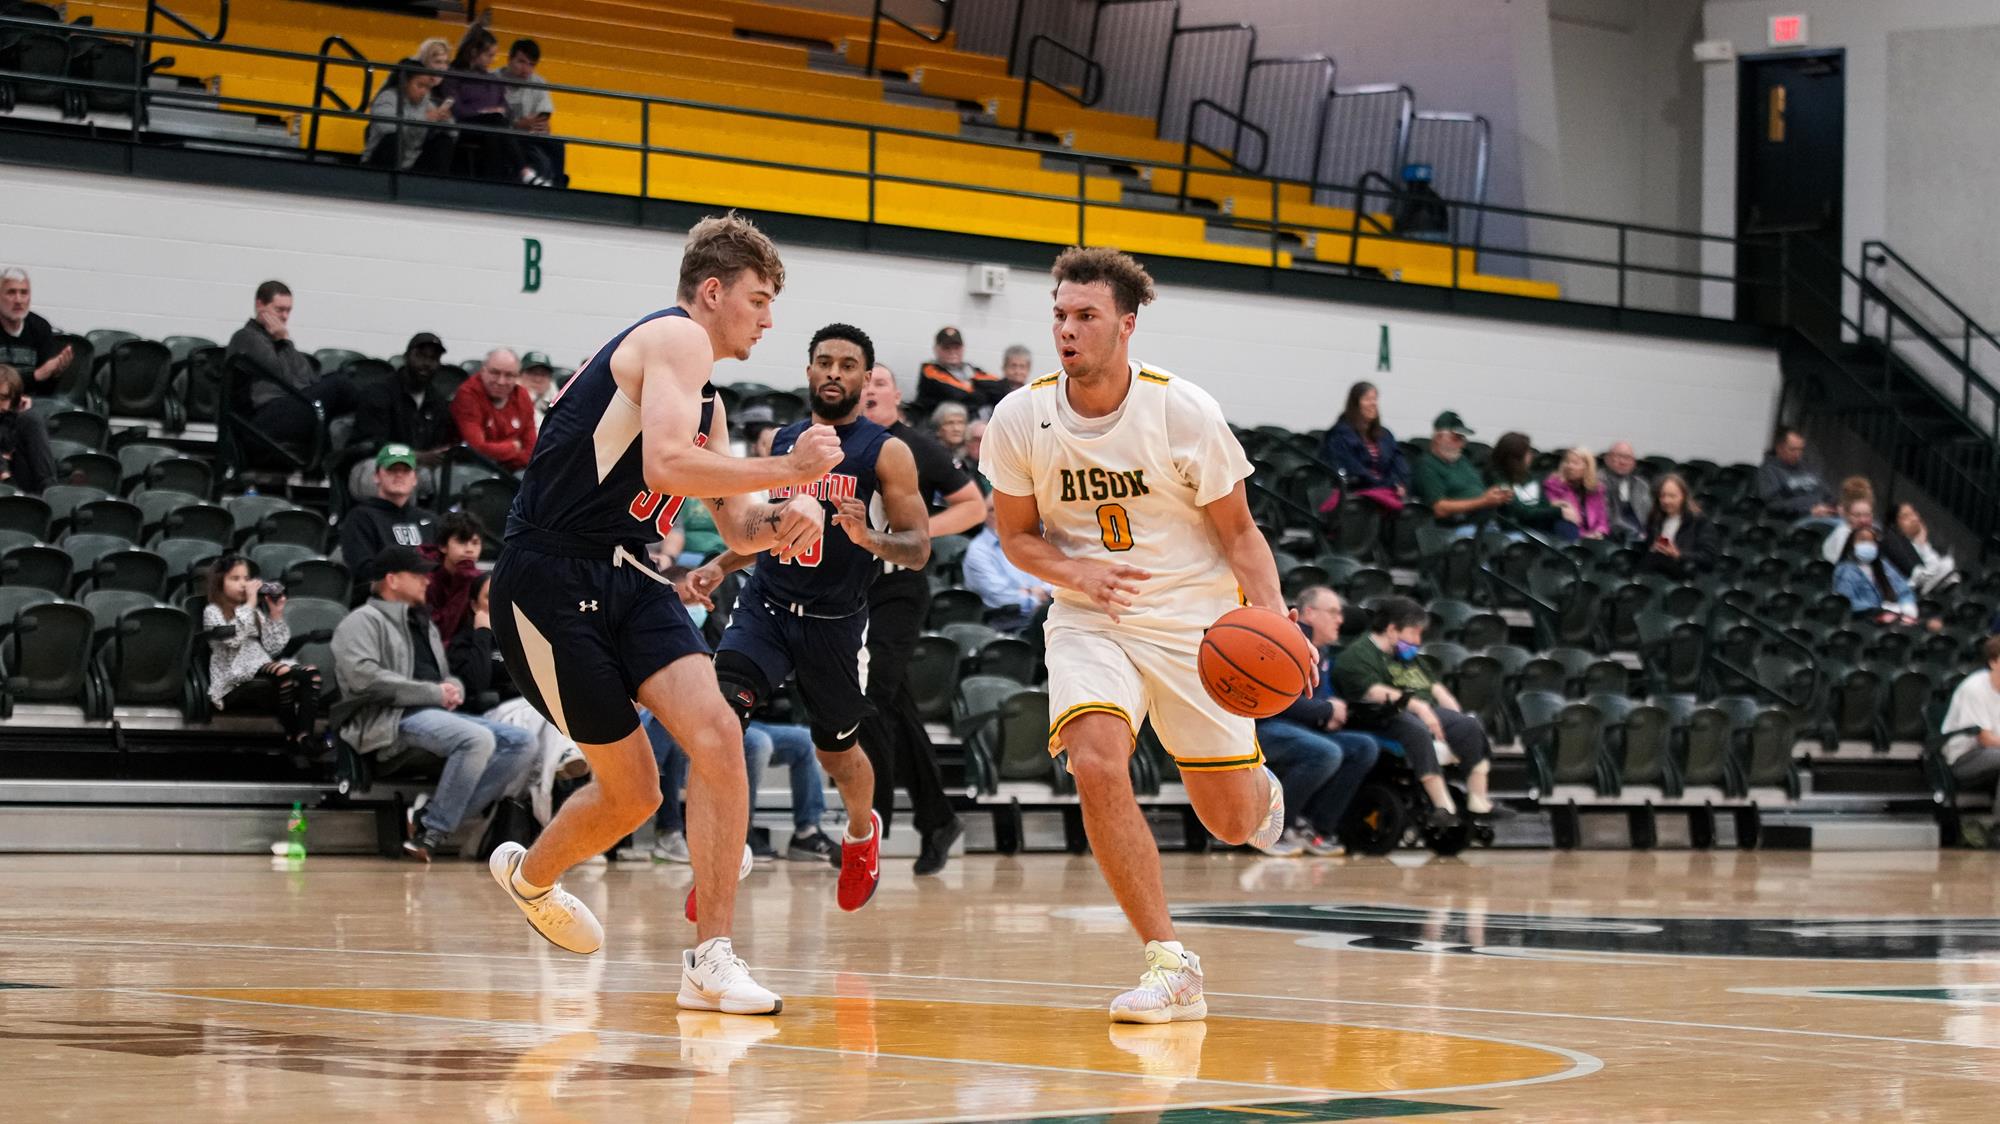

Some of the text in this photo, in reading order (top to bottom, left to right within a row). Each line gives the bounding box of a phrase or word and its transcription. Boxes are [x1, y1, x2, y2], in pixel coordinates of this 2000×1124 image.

[521, 237, 542, 294] B
[1377, 325, 1392, 372] A
[1060, 467, 1150, 502] BISON
[1095, 503, 1135, 553] 0
